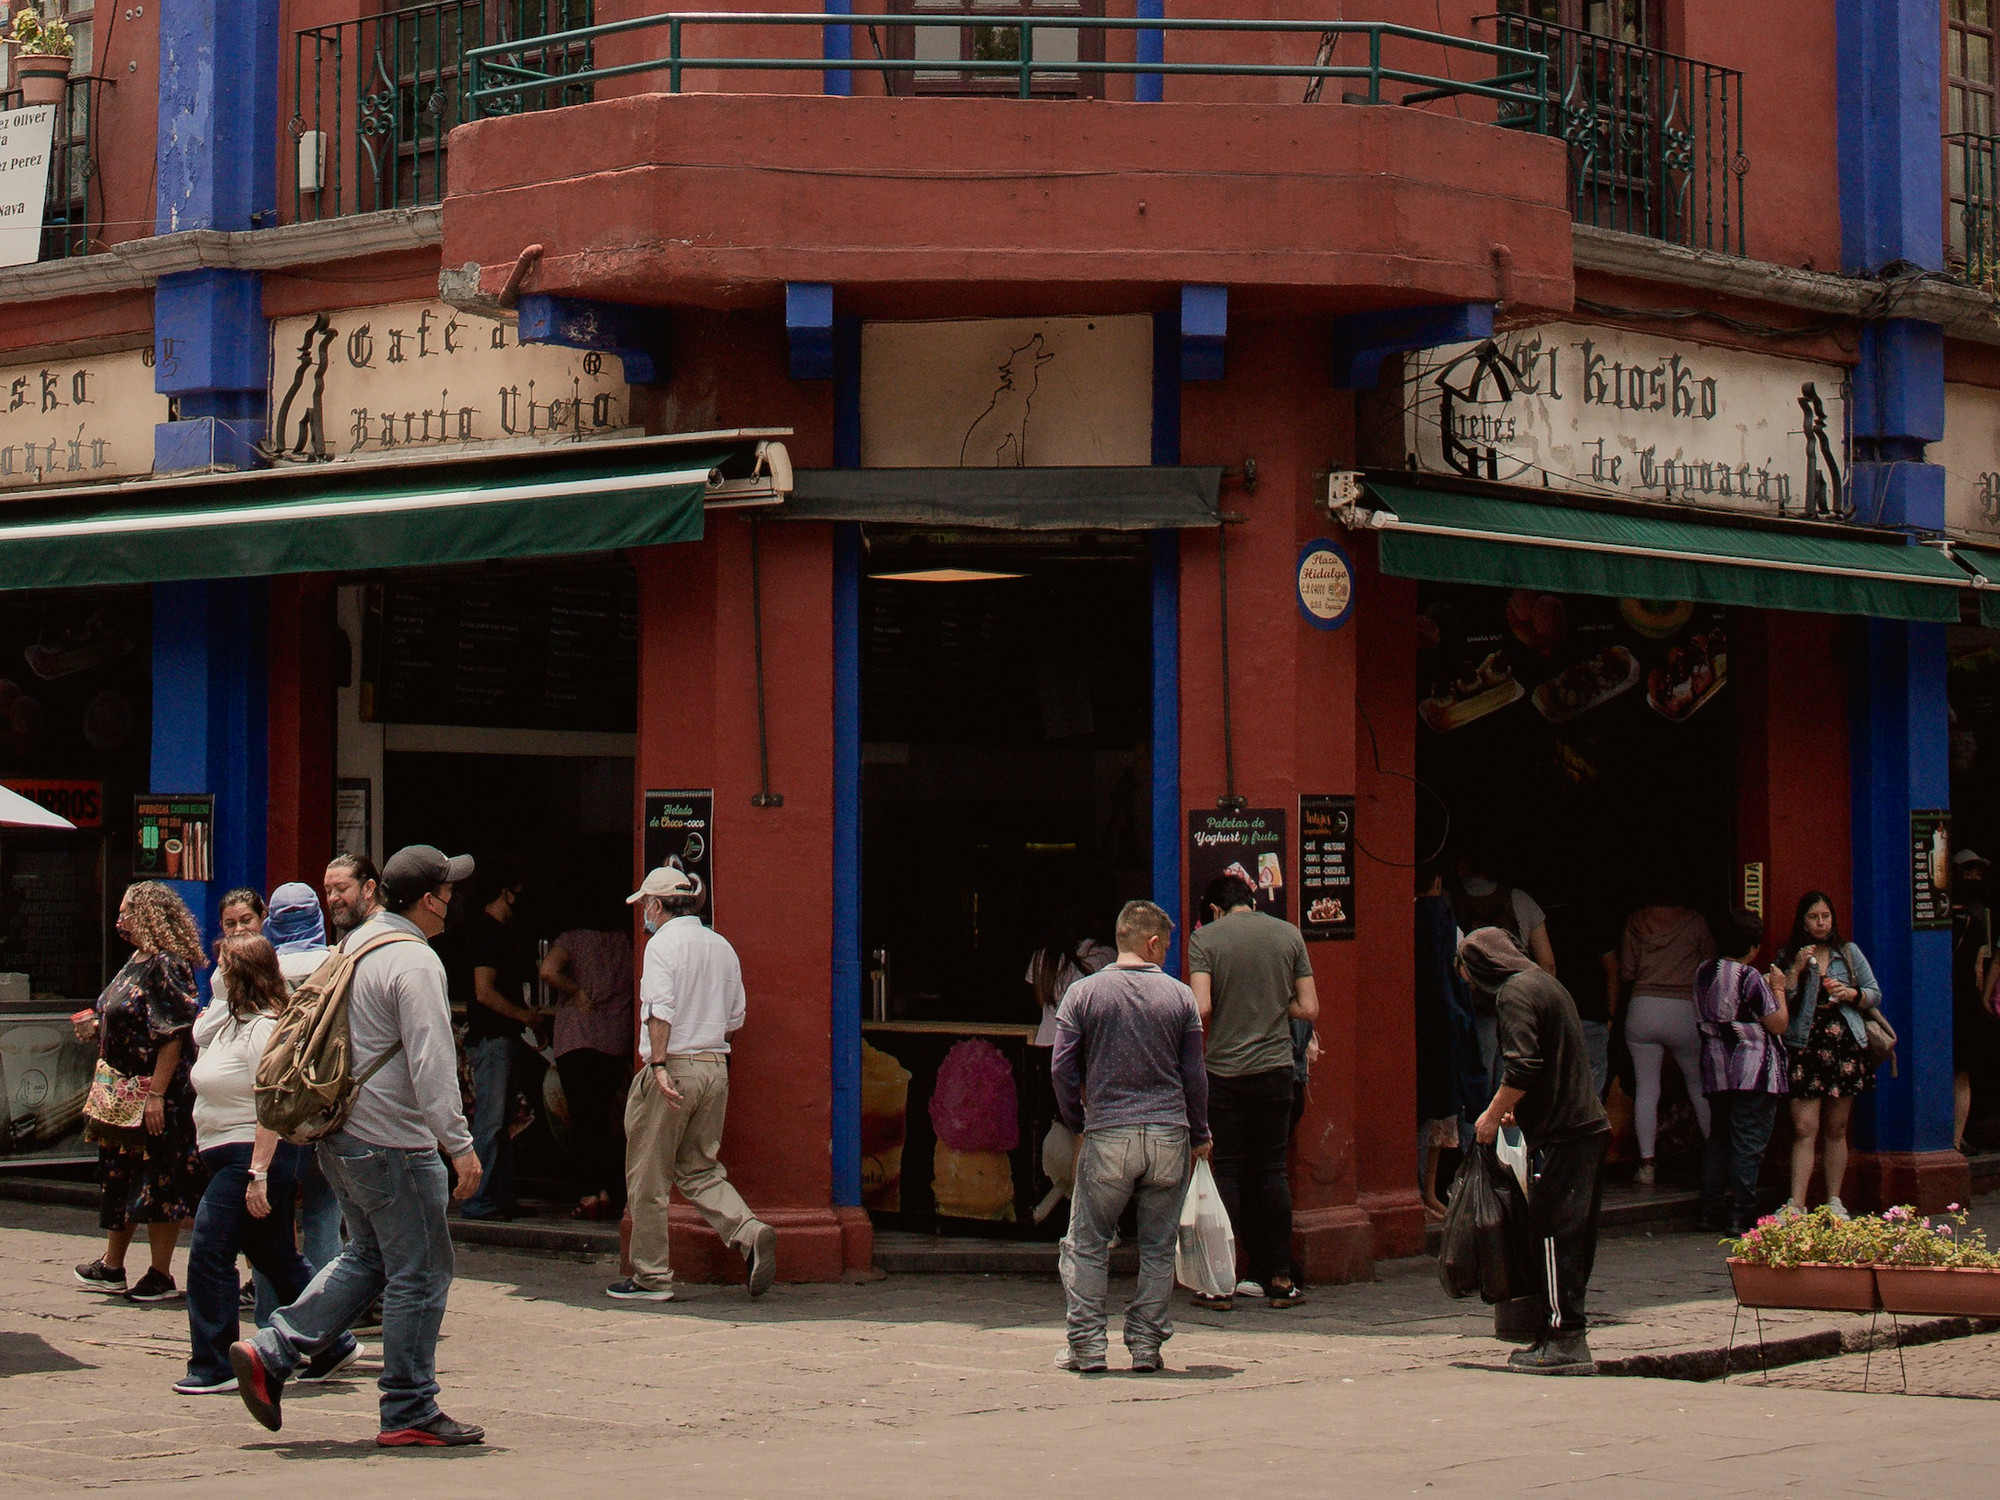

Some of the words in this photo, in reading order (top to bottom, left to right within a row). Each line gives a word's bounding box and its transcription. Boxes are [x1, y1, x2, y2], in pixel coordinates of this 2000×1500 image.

[14, 111, 47, 127] Oliver
[11, 154, 42, 170] Perez
[1592, 437, 1622, 485] de
[1641, 444, 1791, 503] Coyoacán
[1312, 553, 1338, 566] Plaza
[1301, 567, 1348, 581] Hidalgo
[664, 803, 693, 816] Helado
[1207, 816, 1249, 829] Paletas
[1251, 816, 1266, 828] de
[1194, 831, 1240, 846] Yoghurt
[1250, 830, 1280, 845] fruta
[1746, 863, 1760, 908] ALIDA
